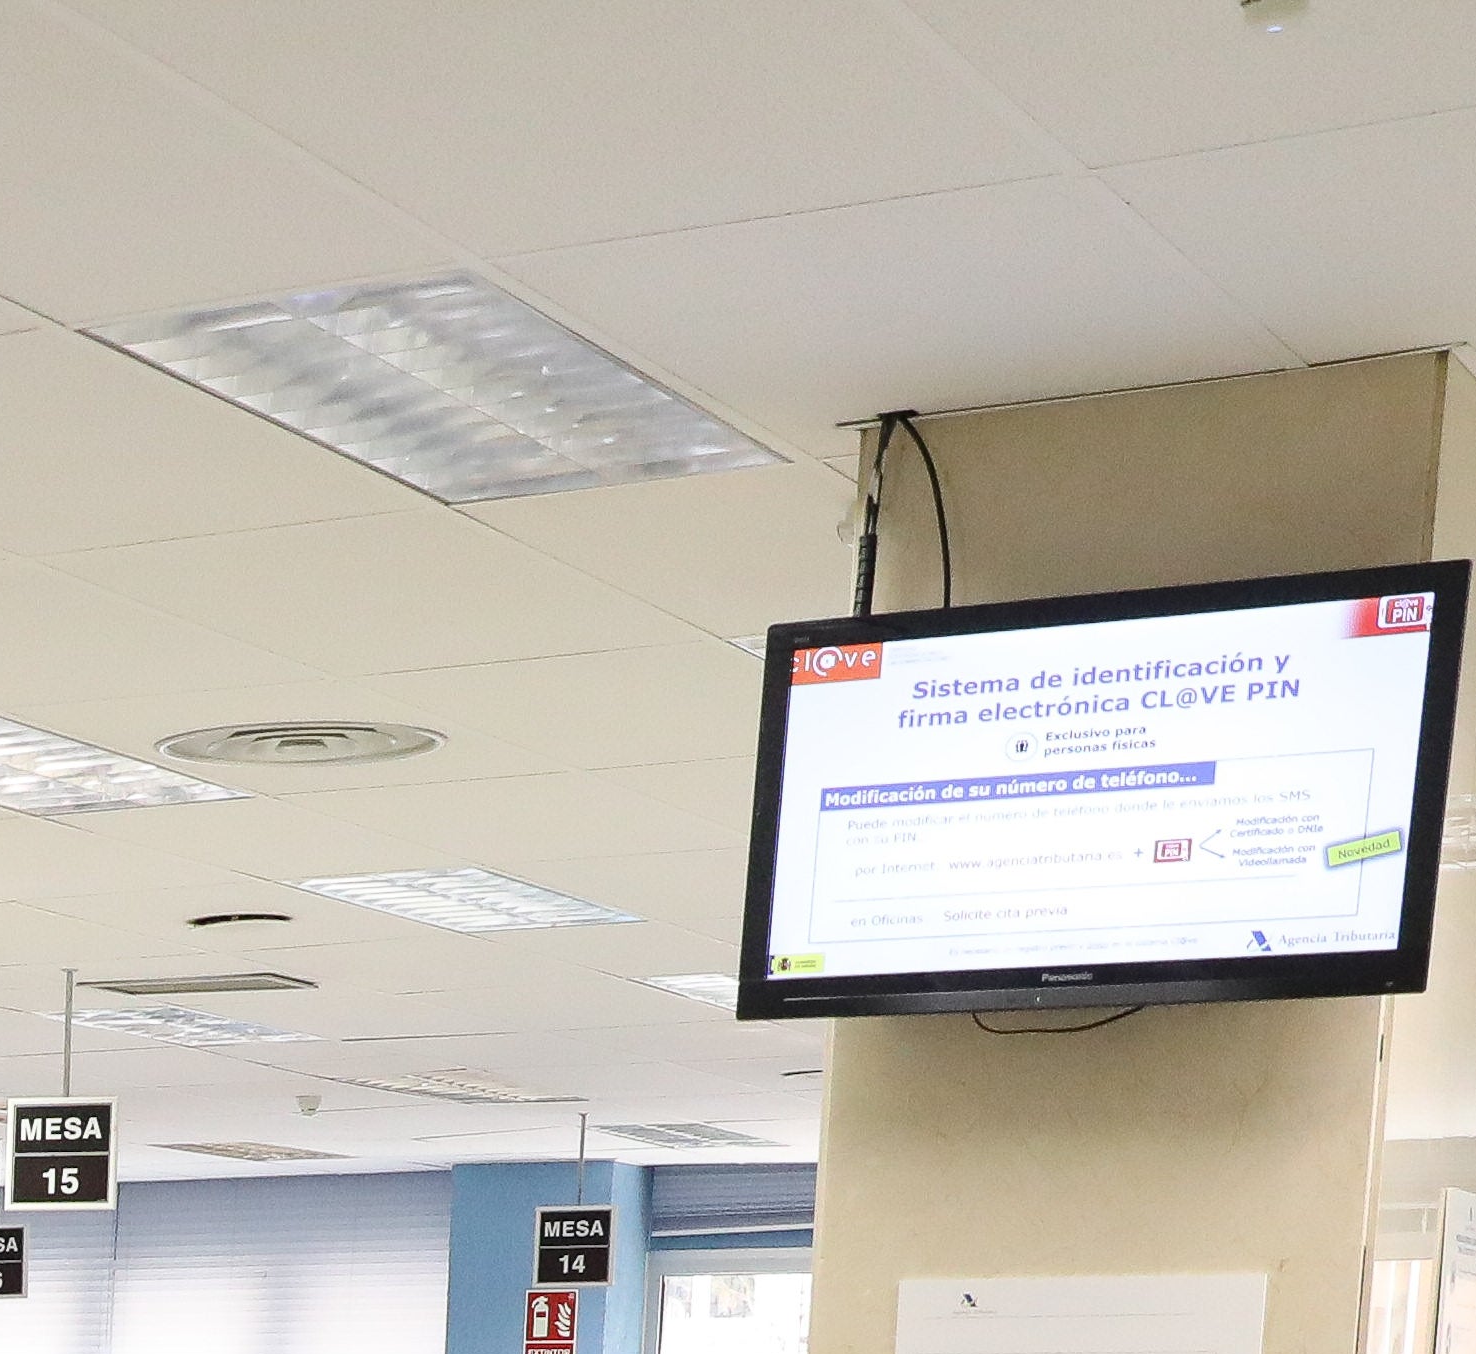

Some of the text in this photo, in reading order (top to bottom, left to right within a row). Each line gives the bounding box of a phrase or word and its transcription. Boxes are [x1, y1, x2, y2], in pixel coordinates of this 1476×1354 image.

[1392, 607, 1418, 623] PIN
[912, 652, 1290, 700] Sistema de identificación y
[898, 679, 1300, 729] firma electrónica CL@VE PIN
[1046, 727, 1147, 742] Exclusivo para
[1044, 741, 1108, 757] personas
[825, 767, 1197, 807] Modificación de su número de teléfono...
[848, 818, 888, 831] Puede
[892, 814, 953, 828] modificar
[1031, 808, 1048, 818] de
[1114, 800, 1158, 813] donde
[1163, 798, 1174, 810] le
[1180, 795, 1249, 808] enviamos
[1254, 792, 1274, 804] los
[1280, 790, 1311, 801] SMS
[1236, 814, 1320, 826] Modificación con
[1230, 825, 1284, 838] Certificado
[1233, 844, 1316, 857] Modificación con
[1338, 838, 1391, 860] Novedad
[1239, 855, 1307, 868] Videollamada
[851, 904, 1069, 928] en Oficinas Solicite cita previa
[1278, 928, 1396, 948] Agencia Tributaria
[1042, 971, 1093, 983] Panasonic
[20, 1116, 102, 1142] MESA
[42, 1167, 80, 1195] 15
[544, 1219, 604, 1238] MESA
[558, 1254, 586, 1274] 14
